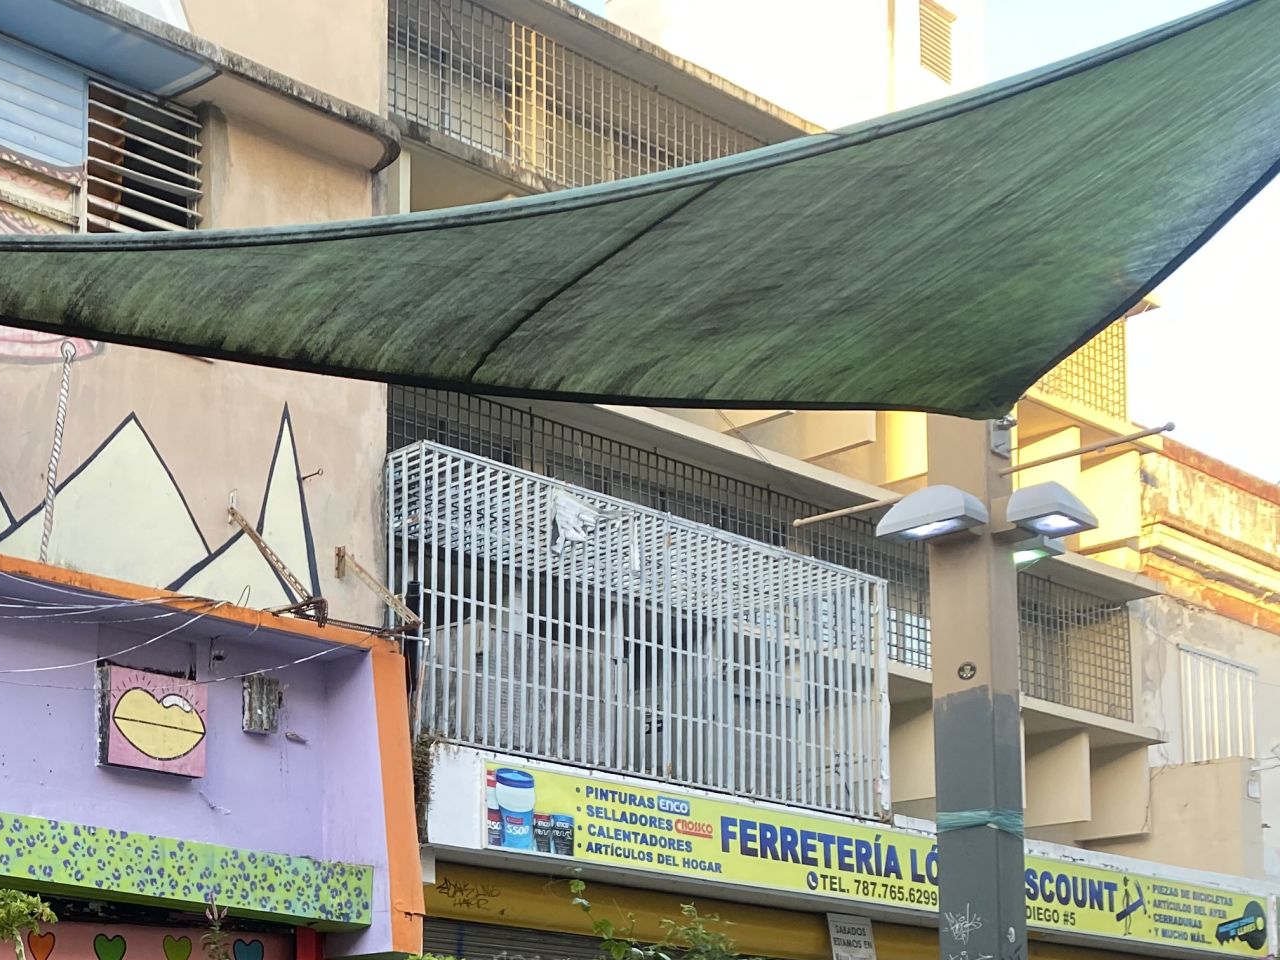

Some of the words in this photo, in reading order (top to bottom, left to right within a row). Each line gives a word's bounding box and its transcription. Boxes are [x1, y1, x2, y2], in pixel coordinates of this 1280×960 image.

[586, 785, 655, 810] PINTURAS
[586, 805, 673, 832] SELLADORES
[674, 818, 713, 838] CROSSCO
[587, 823, 693, 853] CALENTADORES
[720, 815, 903, 881] FERRETERÍA
[586, 841, 654, 863] ARTÍCULOS
[657, 852, 679, 867] DEL
[682, 857, 723, 874] HOGAR
[819, 873, 850, 894] TEL.
[854, 878, 938, 907] 787.765.6299
[1152, 884, 1179, 898] PIEZAS
[1181, 889, 1191, 899] DE
[1192, 891, 1233, 907] BICICLETAS
[1063, 910, 1076, 926] #5
[1153, 897, 1192, 914] ARTÍCULOS
[1153, 913, 1203, 930] CERRADURAS
[1154, 927, 1159, 937] Y
[1161, 928, 1189, 941] MUCHO
